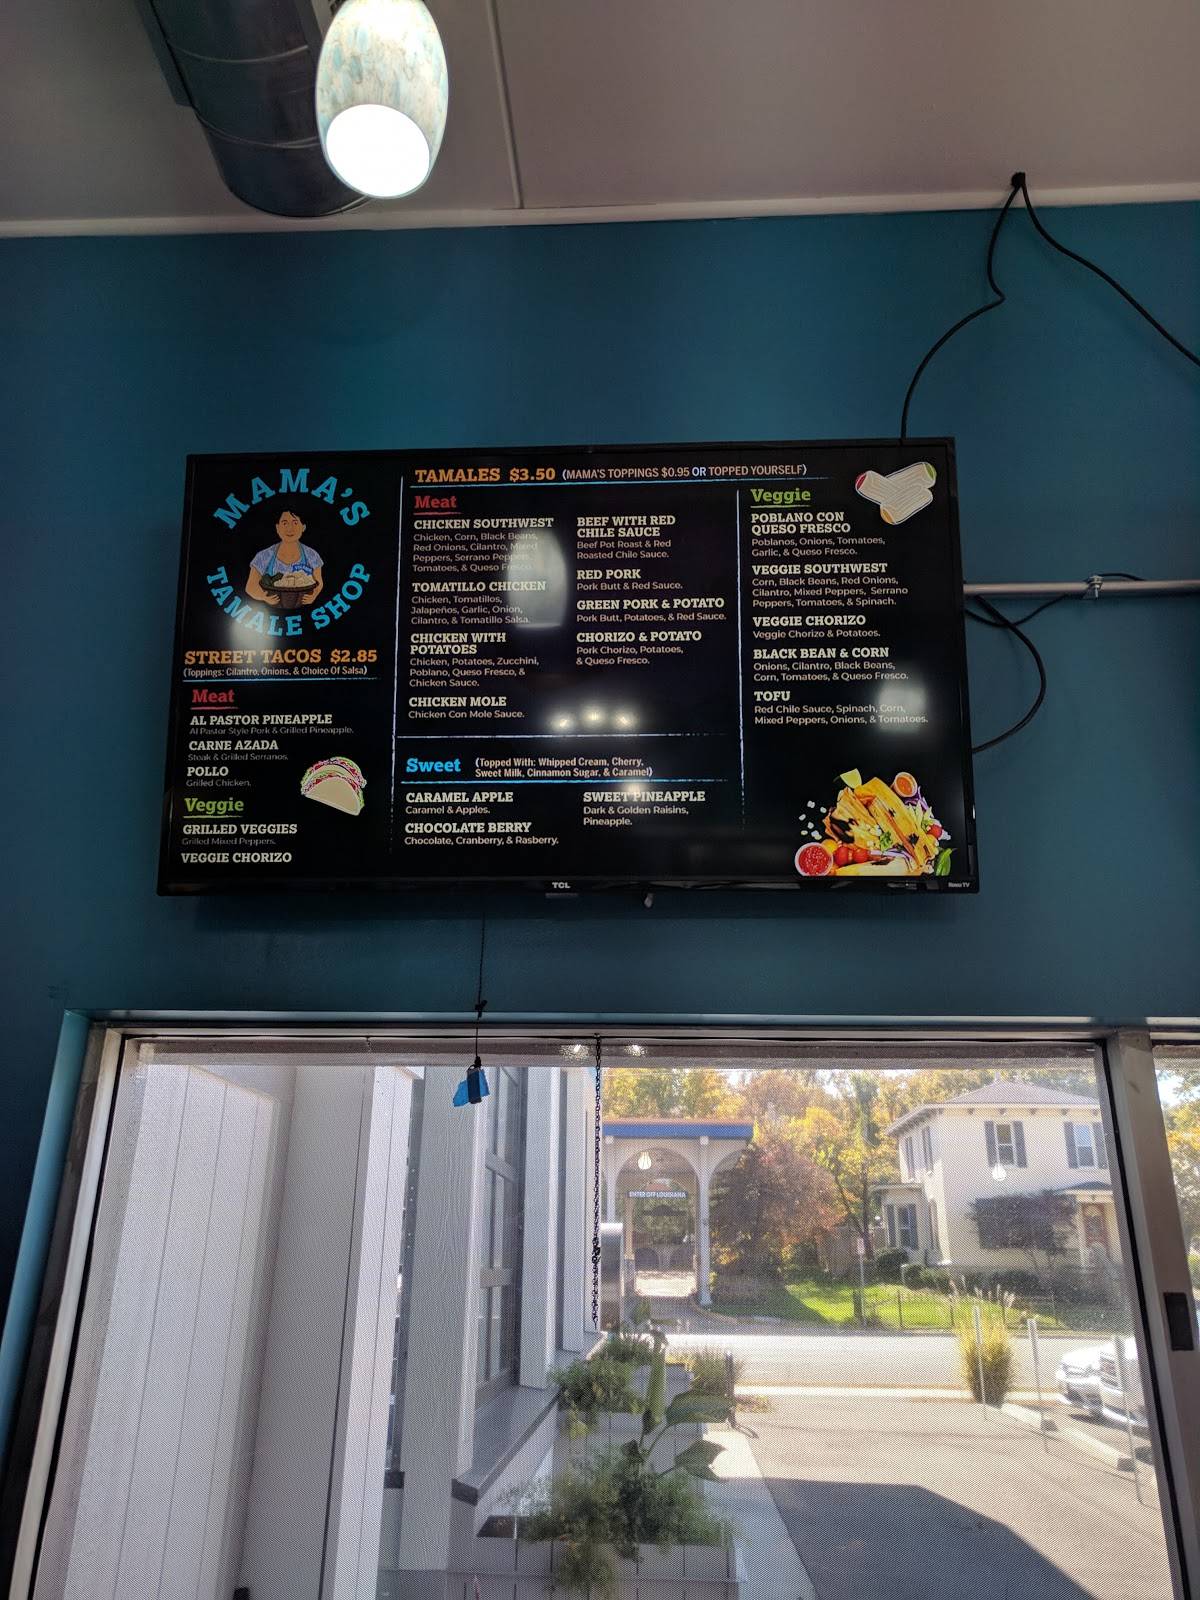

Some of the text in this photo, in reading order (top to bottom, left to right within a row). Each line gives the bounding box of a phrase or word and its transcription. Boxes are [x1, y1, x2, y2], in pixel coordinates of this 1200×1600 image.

[415, 465, 807, 482] TAMALES $3.50 (MAMA'S TOPPINGS $0.95 OR TOPPED YOURSELF)
[213, 468, 370, 530] MAMA'S
[751, 489, 810, 504] Veggie
[414, 496, 456, 508] Meat
[577, 515, 675, 527] BEEF WITH RED
[751, 512, 844, 522] POBLANO CON
[414, 518, 554, 529] CHICKEN SOUTHWEST
[577, 527, 660, 538] CHILE SAUCE
[752, 523, 850, 535] QUESO FRESCO
[752, 563, 887, 574] VEGGIE SOUTHWEST
[577, 569, 641, 579] RED PORK
[412, 581, 546, 592] TOMATILLO CHICKEN
[206, 562, 371, 637] TAMALE SHOP
[577, 598, 724, 609] GREEN PORK & POTATO
[847, 598, 853, 606] &
[753, 616, 866, 626] VEGGIE CHORIZO
[411, 632, 506, 643] CHICKEN WITH
[577, 631, 702, 642] CHORIZO & POTATO
[753, 630, 786, 639] Veggie
[788, 630, 824, 639] Chorizo
[827, 630, 834, 638] &
[410, 645, 477, 655] POTATOES
[577, 646, 598, 655] Pork
[754, 648, 889, 658] BLACK BEAN & CORN
[185, 650, 377, 664] STREET TACOS $2.85
[576, 657, 583, 666] &
[585, 657, 615, 665] Queso
[192, 690, 234, 703] Meat
[754, 692, 790, 701] TOFU
[409, 697, 506, 707] CHICKEN MOLE
[190, 714, 332, 725] AL PASTOR PINEAPPLE
[189, 740, 278, 750] CARNE AZADA
[406, 758, 461, 772] Sweet
[475, 758, 511, 768] (Topped
[514, 758, 536, 768] With:
[538, 758, 576, 767] Whipped
[187, 767, 228, 776] POLLO
[475, 768, 502, 777] Sweet
[527, 768, 571, 777] Cinnamon
[603, 768, 610, 777] &
[612, 768, 652, 777] Caramel)
[406, 792, 513, 803] CARAMEL APPLE
[584, 792, 705, 802] SWEET PINEAPPLE
[184, 798, 244, 814] Veggie
[406, 806, 444, 815] Caramel
[447, 805, 453, 815] &
[584, 806, 605, 815] Dark
[608, 806, 614, 815] &
[617, 805, 651, 815] Golden
[183, 824, 297, 834] GRILLED VEGGIES
[405, 822, 531, 833] CHOCOLATE BERRY
[506, 836, 512, 846] &
[181, 853, 292, 863] VEGGIE CHORIZO
